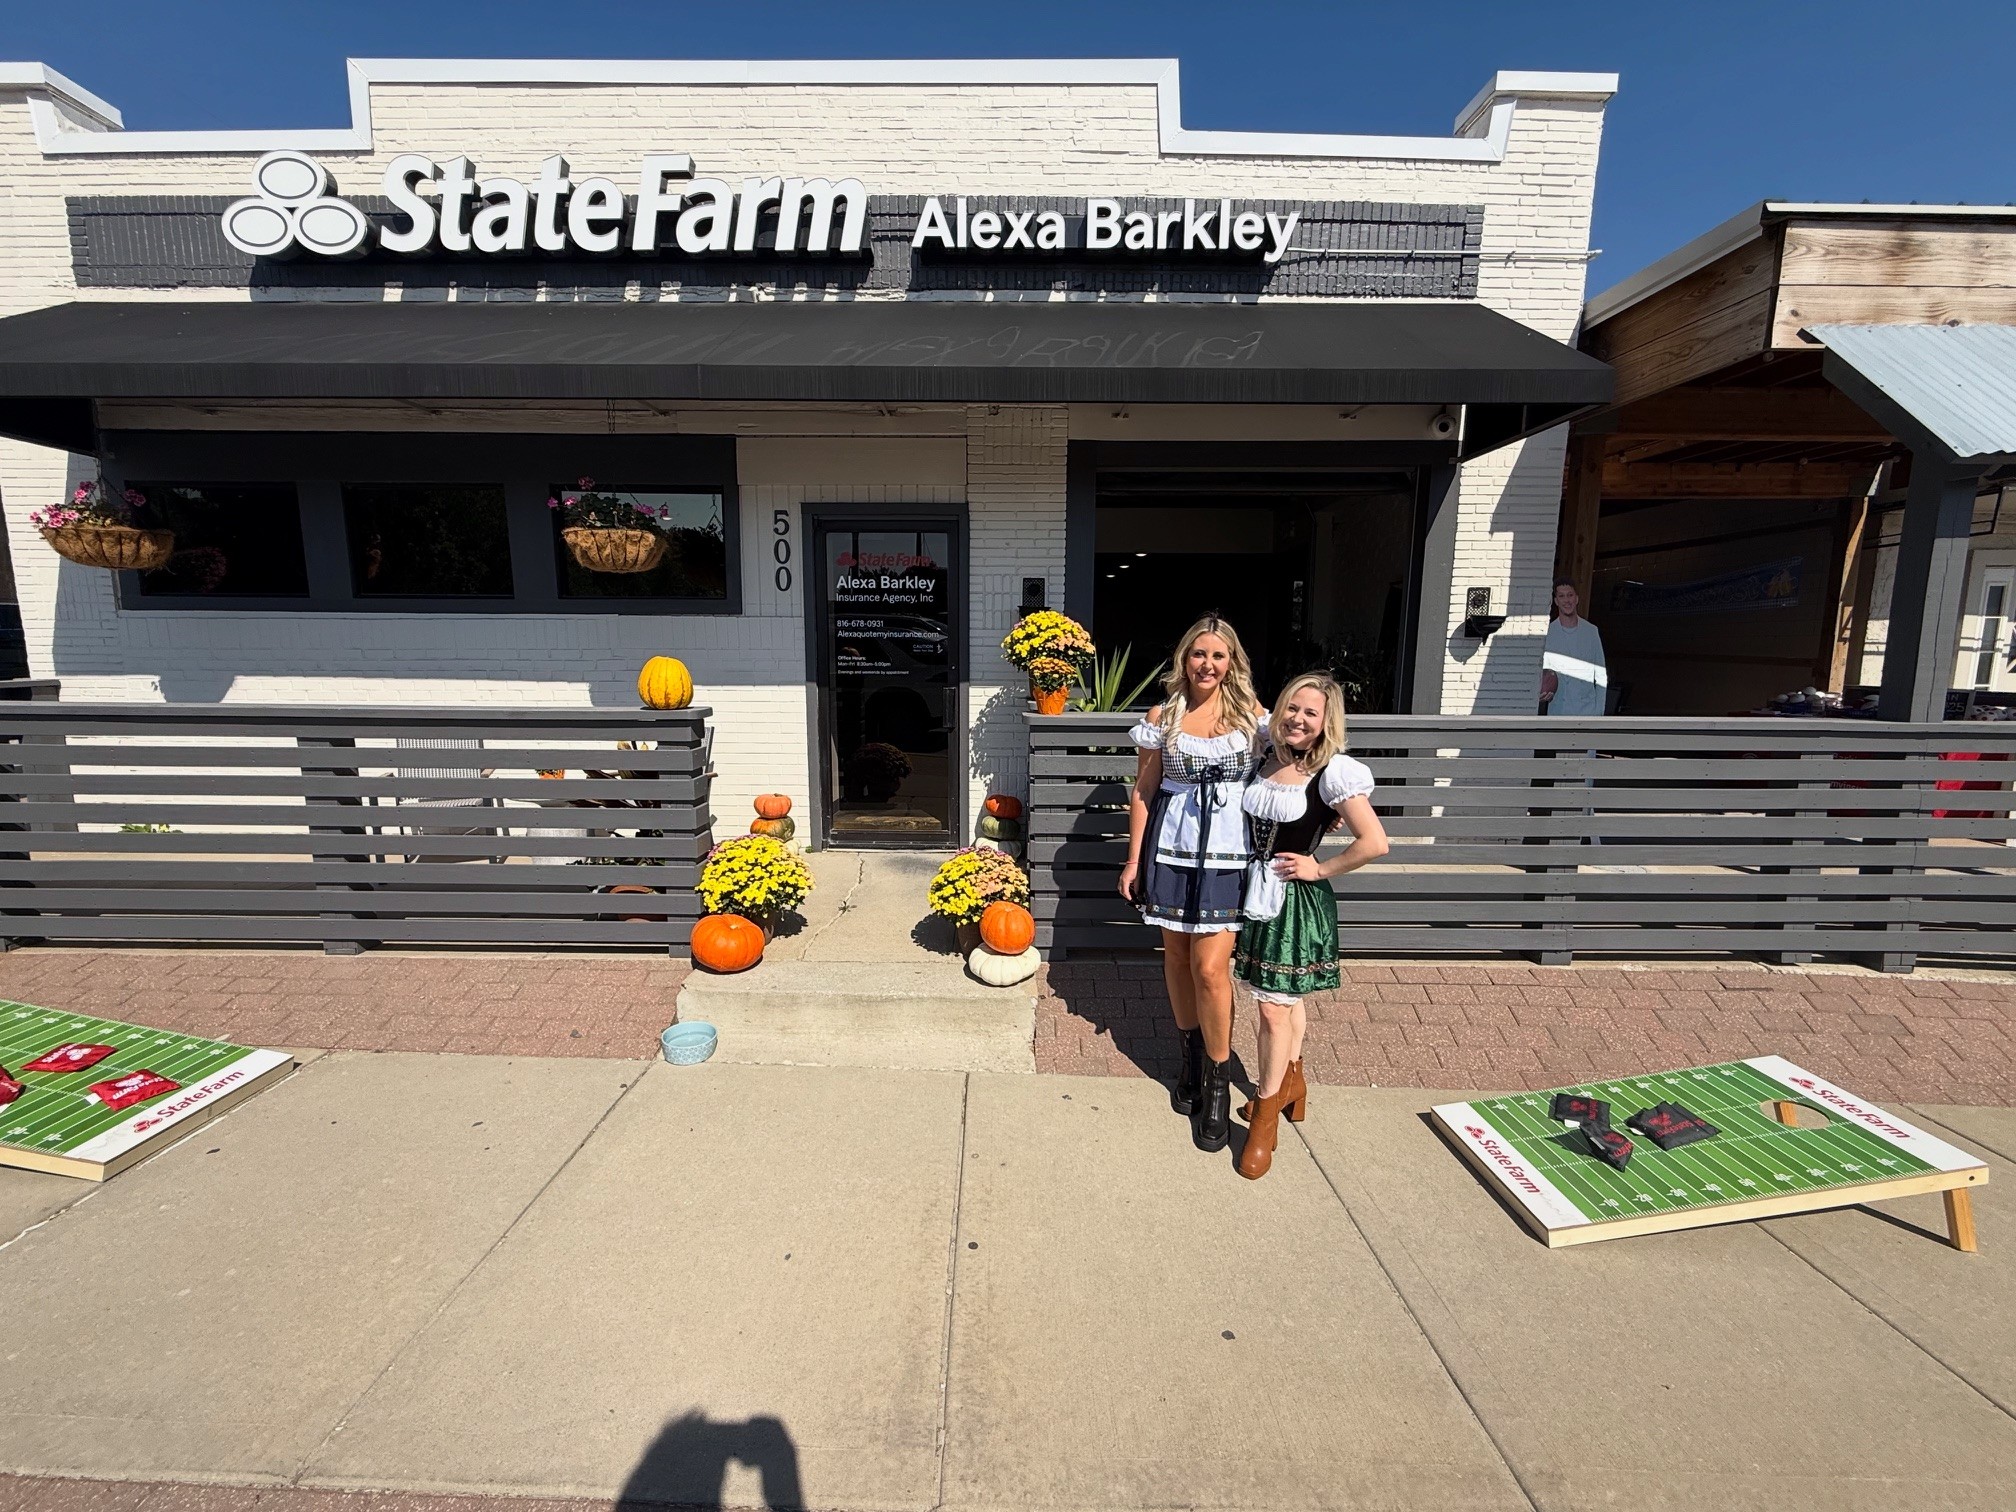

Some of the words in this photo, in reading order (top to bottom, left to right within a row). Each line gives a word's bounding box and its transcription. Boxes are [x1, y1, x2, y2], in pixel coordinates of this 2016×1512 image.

[912, 198, 1066, 250] Alexa
[1086, 198, 1300, 263] Barkley
[773, 509, 792, 592] 500
[836, 575, 876, 589] Alexa
[880, 575, 936, 592] Barkley
[836, 593, 880, 602] Insurance
[882, 593, 918, 604] Agency,
[920, 593, 934, 602] Inc
[837, 620, 884, 628] 816-678-0931
[1636, 1194, 1653, 1202] 20
